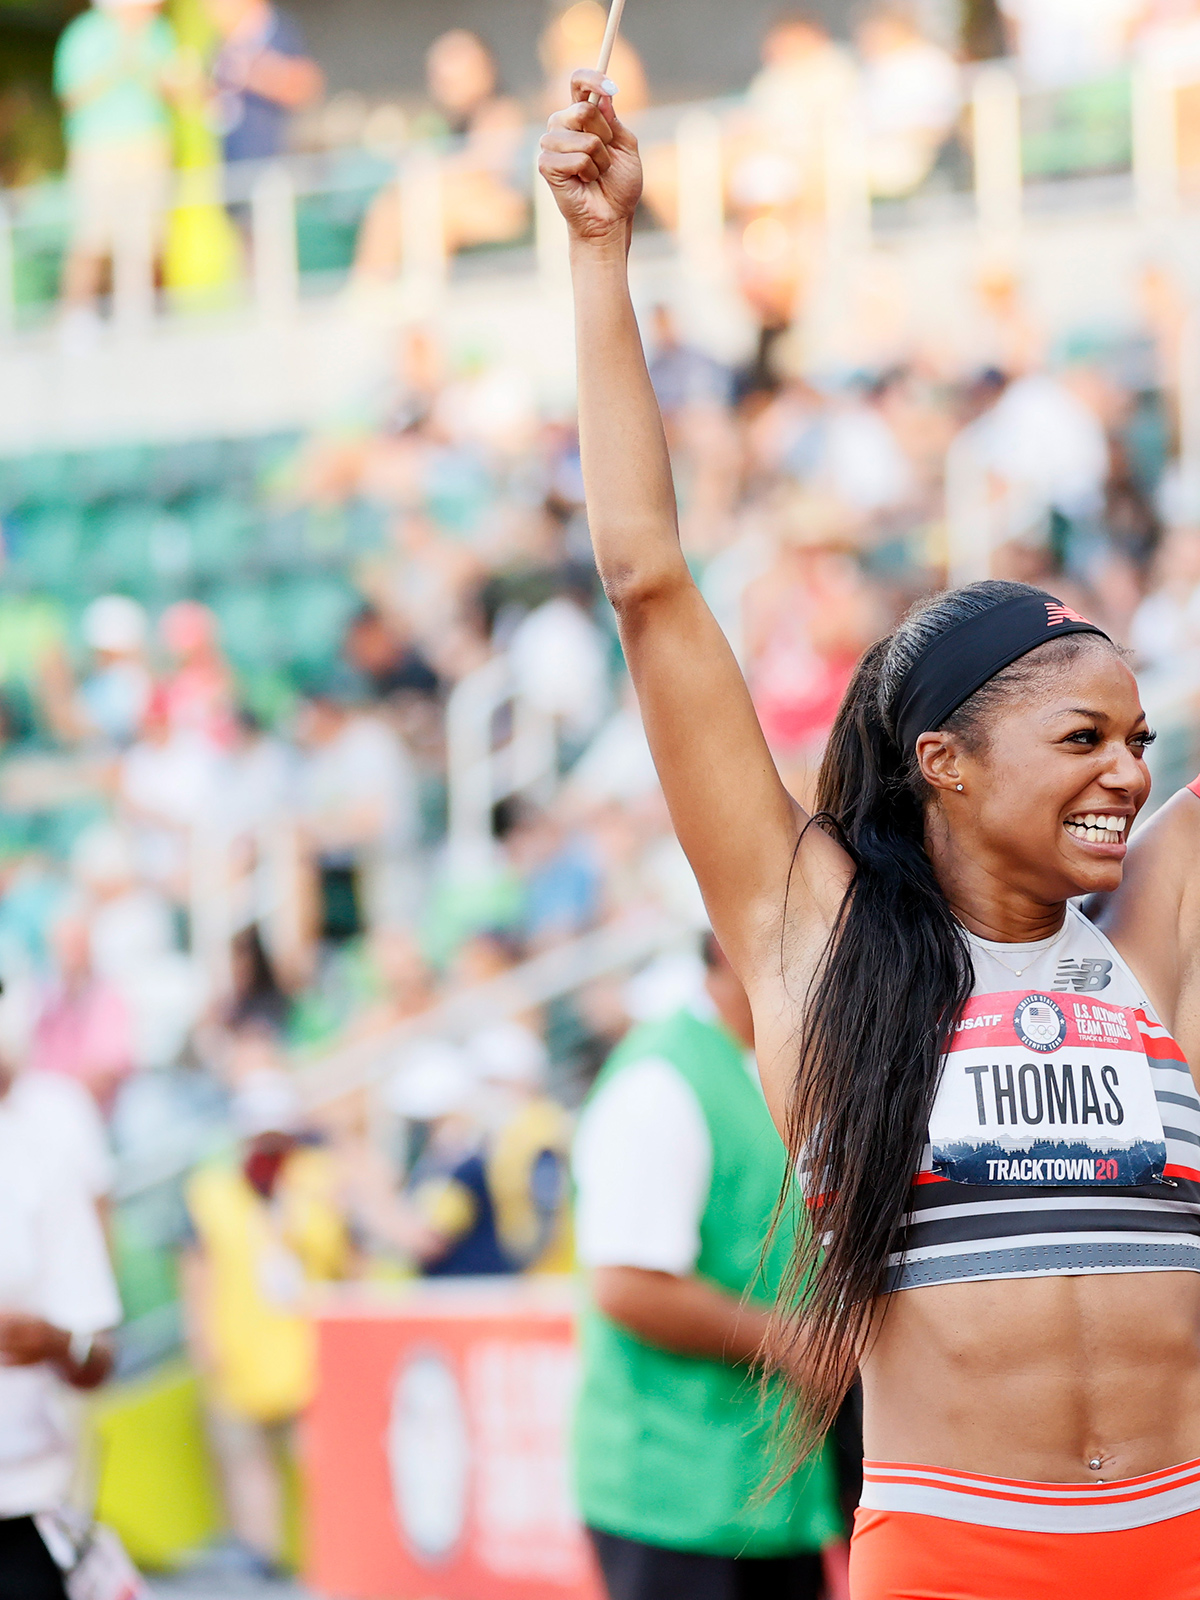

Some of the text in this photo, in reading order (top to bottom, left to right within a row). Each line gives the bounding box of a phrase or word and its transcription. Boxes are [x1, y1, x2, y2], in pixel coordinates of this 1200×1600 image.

[1073, 1002, 1092, 1019] U.S.
[954, 1014, 1003, 1032] USATF
[1075, 1018, 1132, 1041] TEAM TRIALS
[1078, 1034, 1099, 1042] TRACK
[1103, 1036, 1119, 1044] FIELD
[964, 1063, 1124, 1126] THOMAS
